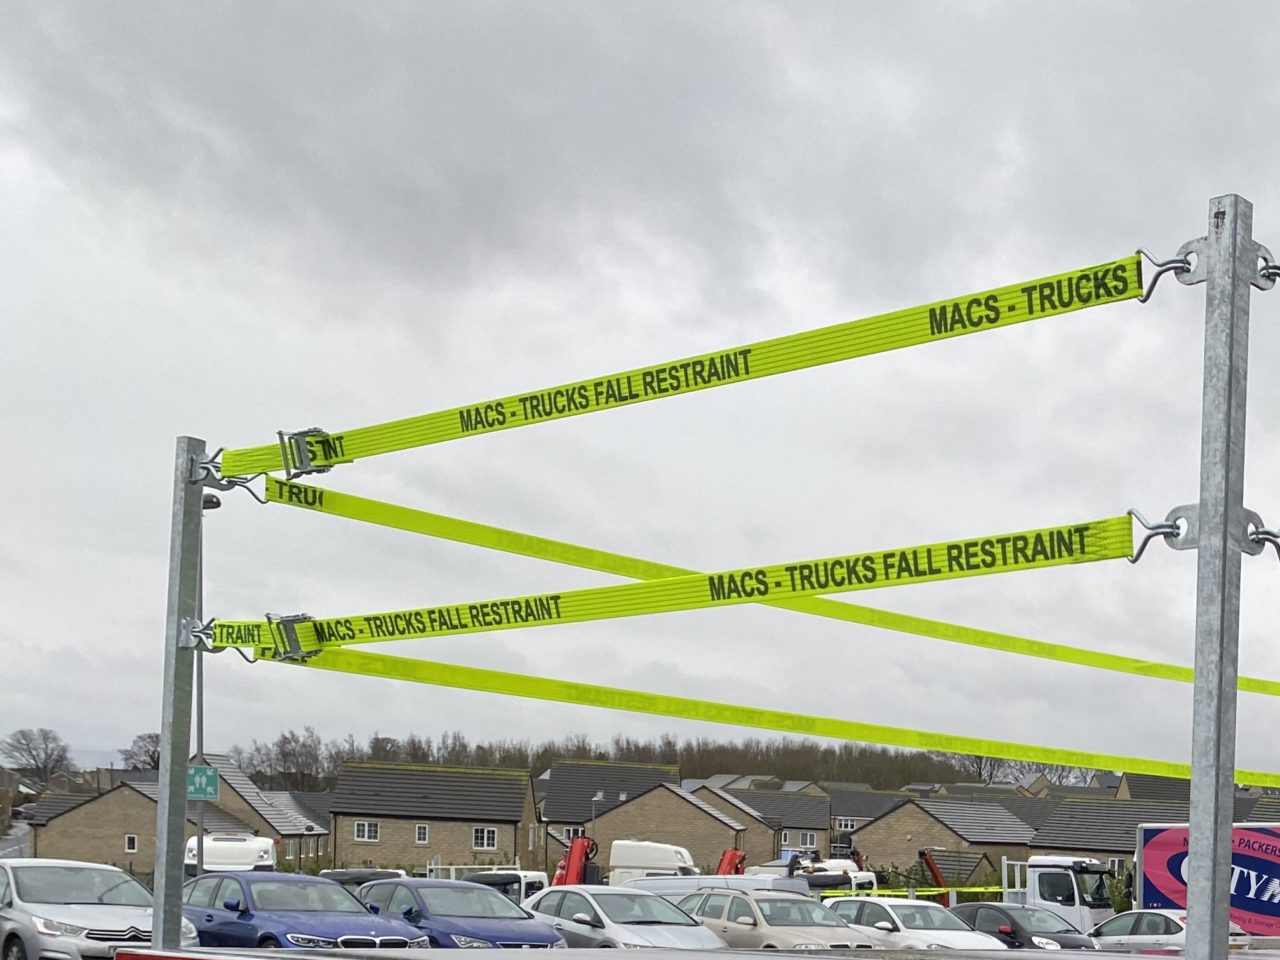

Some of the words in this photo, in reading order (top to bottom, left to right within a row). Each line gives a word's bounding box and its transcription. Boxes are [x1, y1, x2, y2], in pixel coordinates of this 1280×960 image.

[928, 295, 1000, 336] MACS
[1021, 263, 1129, 315] TRUCKS
[459, 402, 507, 433] MACS
[518, 385, 589, 422] TRUCKS
[594, 373, 639, 407] FALL
[643, 349, 752, 396] RESTRAINT
[708, 566, 768, 601] MACS
[785, 552, 877, 590] TRUCKS
[882, 547, 940, 578] FALL
[947, 527, 1089, 571] RESTRAINT
[313, 619, 355, 643] MACS
[363, 612, 425, 637] TRUCKS
[428, 604, 466, 633] FALL
[469, 595, 561, 628] RESTRAINT
